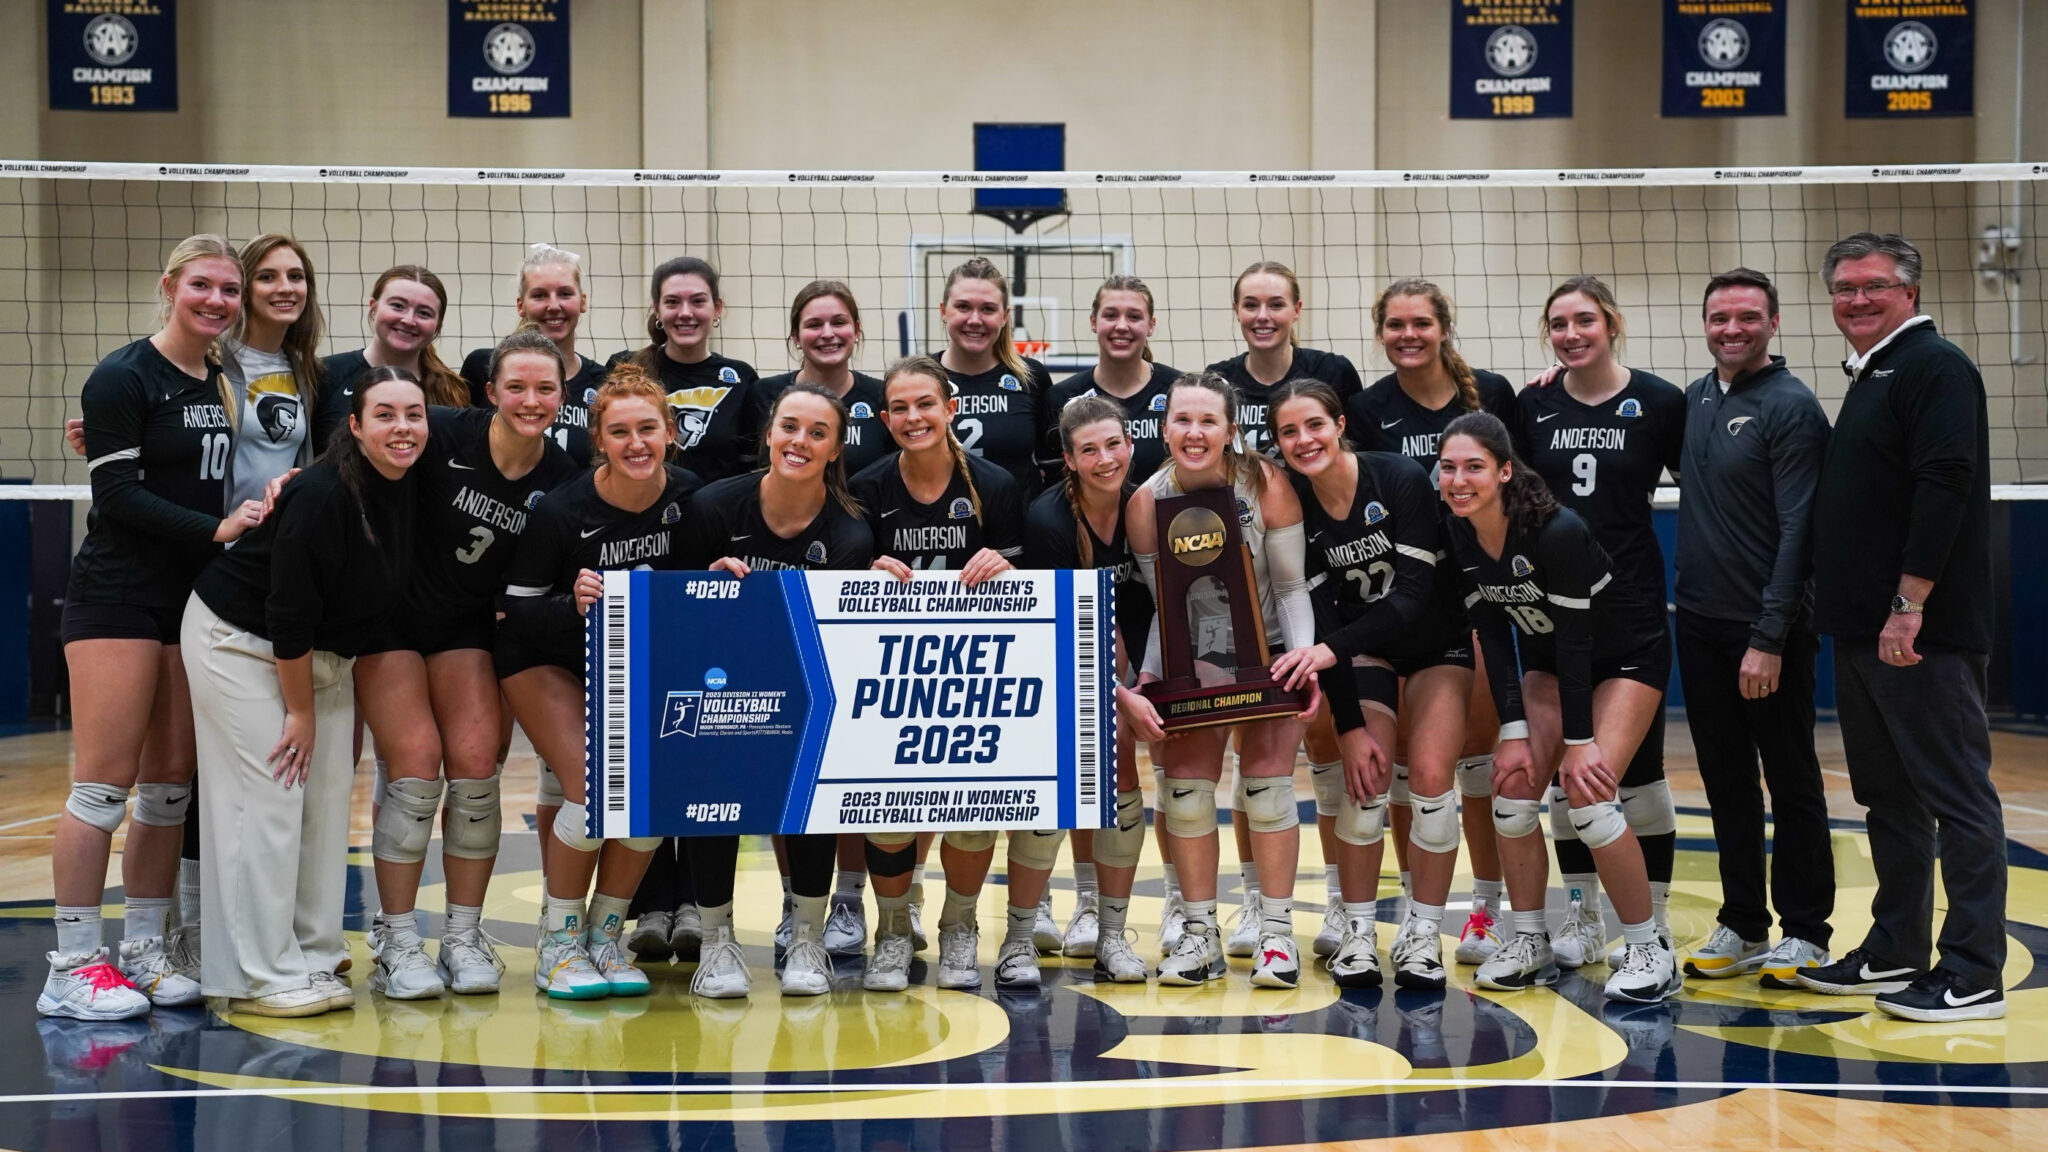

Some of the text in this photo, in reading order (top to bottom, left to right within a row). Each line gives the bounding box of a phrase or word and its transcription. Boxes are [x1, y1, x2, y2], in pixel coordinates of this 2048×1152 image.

[73, 67, 152, 83] CHAMPION
[472, 77, 549, 92] CHAMPION
[1685, 70, 1761, 87] CHAMPION
[1870, 74, 1949, 90] CHAMPION
[1475, 76, 1552, 94] CHAMPION
[89, 85, 136, 105] 1993
[488, 93, 532, 112] 1996
[1491, 95, 1535, 114] 1999
[1701, 88, 1745, 107] 2003
[1886, 91, 1933, 111] 2005
[4, 164, 87, 173] VOLLEYBALL CHAMPIONSHIP
[168, 167, 250, 175] VOLLEYBALL CHAMPIONSHIP
[328, 169, 409, 177] VOLLEYBALL CHAMPIONSHIP
[487, 171, 566, 179] VOLLEYBALL CHAMPIONSHIP
[643, 173, 721, 181] VOLLEYBALL CHAMPIONSHIP
[951, 174, 1028, 182] VOLLEYBALL CHAMPIONSHIP
[1104, 174, 1182, 182] VOLLEYBALL CHAMPIONSHIP
[1258, 174, 1336, 182] VOLLEYBALL CHAMPIONSHIP
[1412, 173, 1490, 181] VOLLEYBALL CHAMPIONSHIP
[1566, 172, 1645, 180] VOLLEYBALL CHAMPIONSHIP
[1723, 170, 1803, 178] VOLLEYBALL CHAMPIONSHIP
[1881, 168, 1962, 176] VOLLEYBALL CHAMPIONSHIP
[955, 394, 1008, 415] DERSON
[957, 418, 984, 457] 2
[1124, 418, 1158, 439] RSON
[1550, 427, 1626, 451] ANDERSON
[200, 433, 230, 480] 10
[1572, 453, 1597, 497] 9
[451, 485, 527, 536] ANDERSON
[455, 525, 496, 565] 3
[893, 525, 967, 552] ANDERSON
[1173, 531, 1224, 554] NCAA
[598, 530, 671, 567] ANDERSON
[1324, 529, 1393, 568] ANDERSON
[685, 580, 741, 599] #D2VB
[840, 580, 1034, 596] 2023 DIVISION II WOMEN'S
[1345, 560, 1396, 603] 22
[1478, 580, 1545, 603] ANDERSON
[838, 596, 1038, 613] VOLLEYBALL CHAMPIONSHIP
[1504, 605, 1554, 635] 18
[878, 634, 1016, 675] TICKET
[703, 698, 781, 713] VOLLEYBALL
[851, 677, 1044, 719] PUNCHED
[1171, 691, 1262, 714] REGIONAL CHAMPION
[700, 713, 770, 724] CHAMPIONSHIP
[894, 724, 1001, 764] 2023
[841, 789, 1037, 807] 2023 DIVISION II WOMEN'S
[685, 803, 742, 822] #D2VB
[839, 806, 1040, 824] VOLLEYBALL CHAMPIONSHIP
